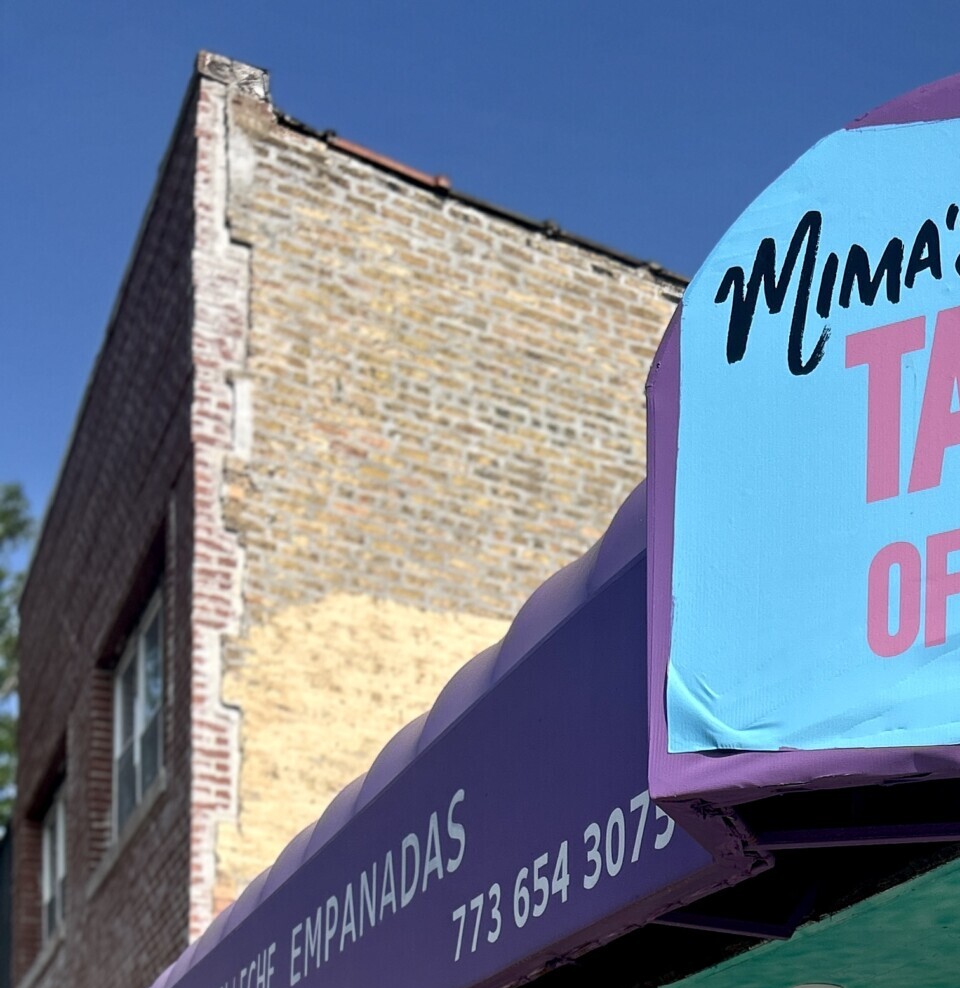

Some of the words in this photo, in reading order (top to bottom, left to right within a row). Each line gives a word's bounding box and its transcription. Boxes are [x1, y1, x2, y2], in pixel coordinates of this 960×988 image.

[290, 788, 467, 987] EMPANADAS
[452, 883, 501, 962] 773
[513, 840, 570, 928] 654
[583, 790, 675, 891] 3075
